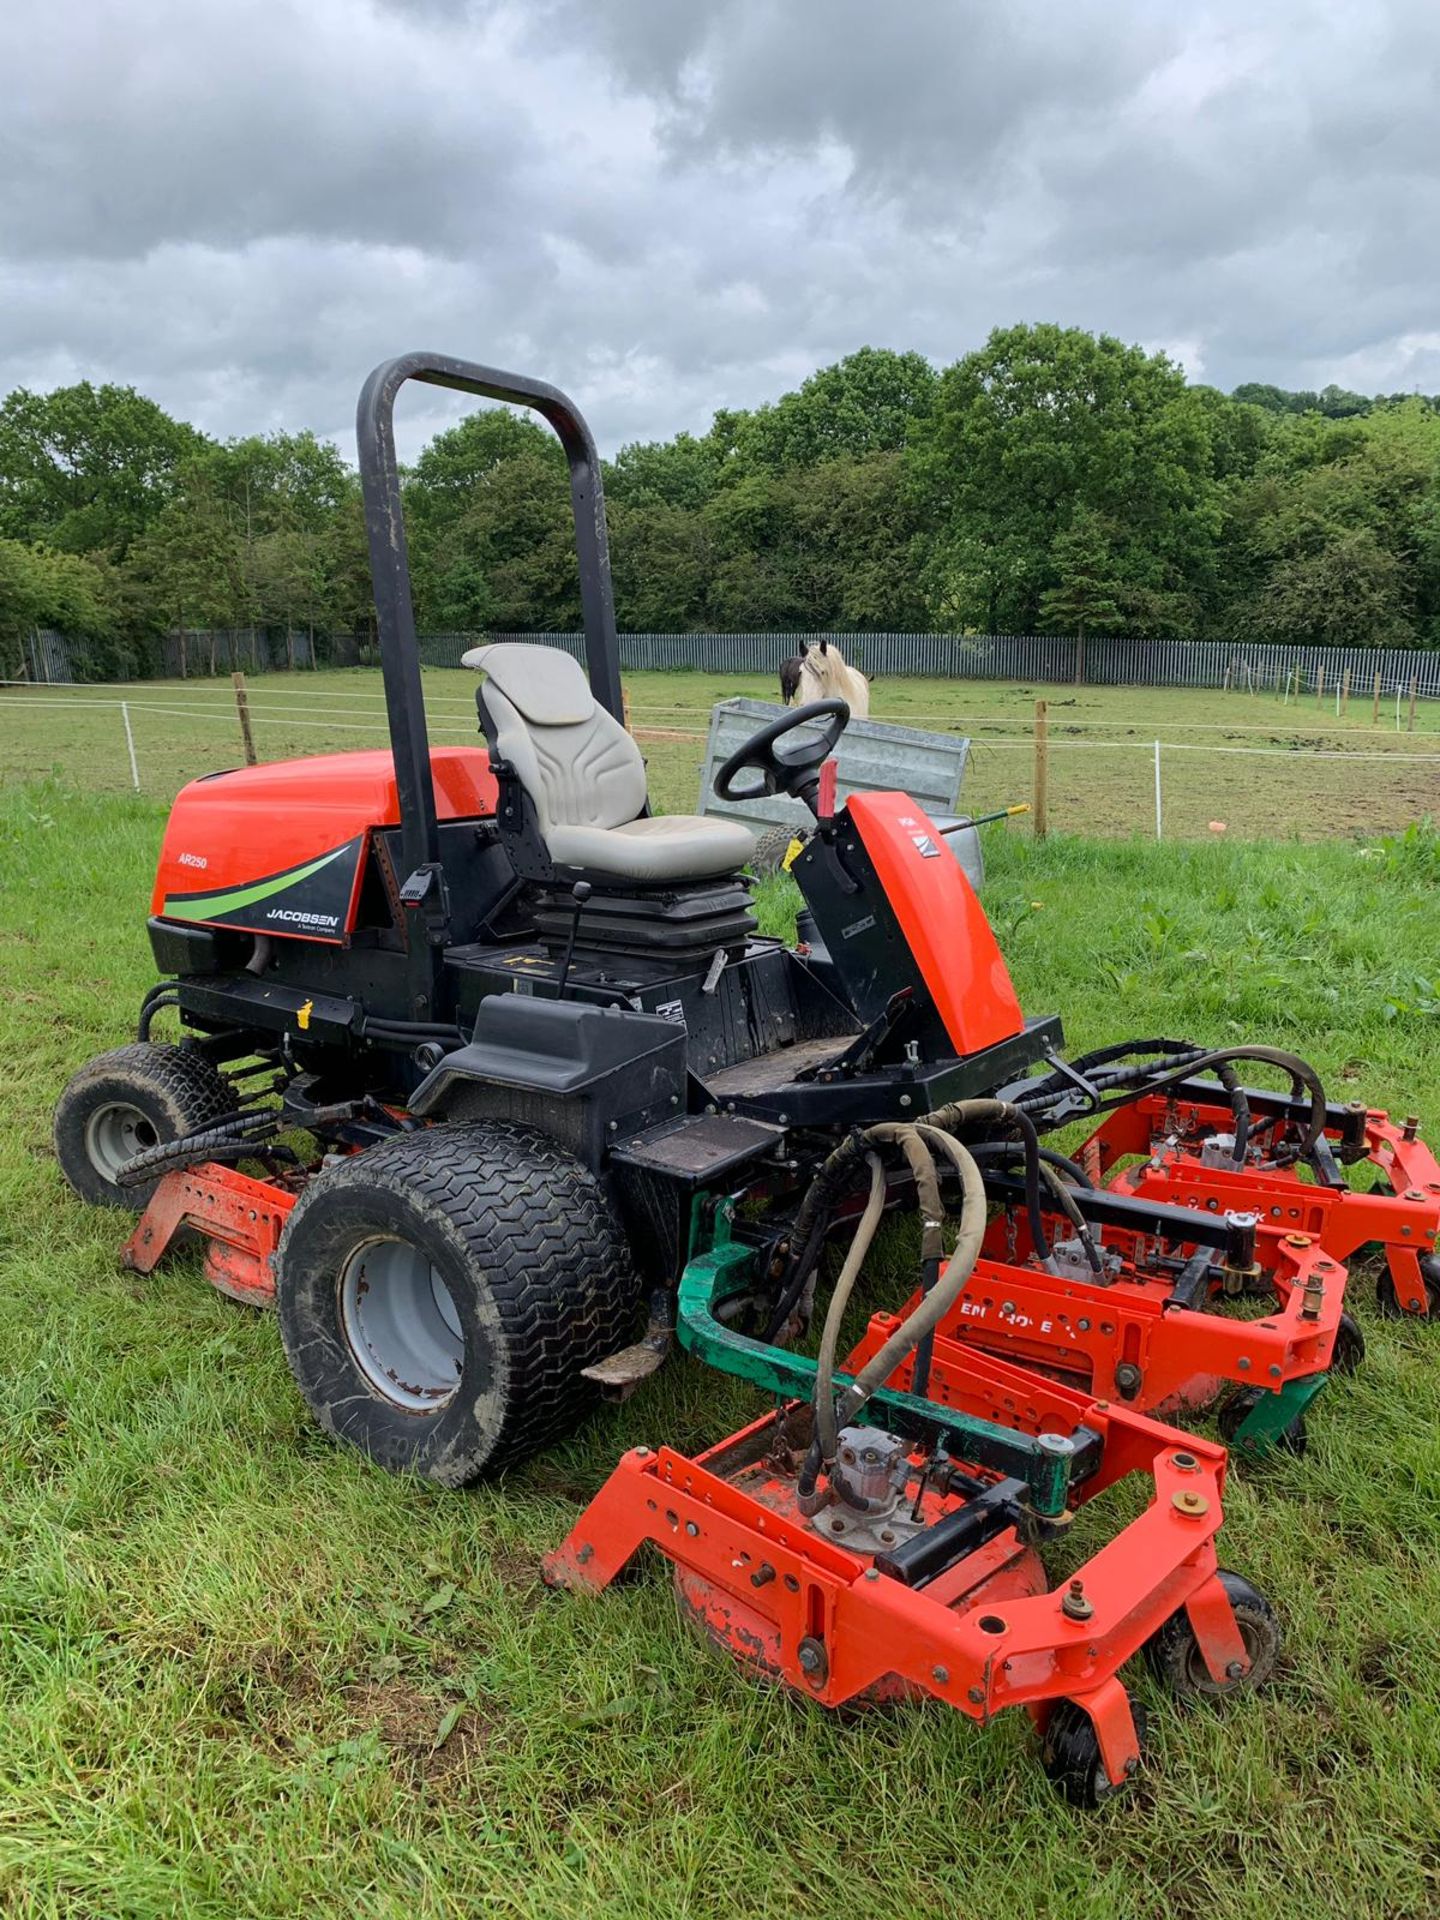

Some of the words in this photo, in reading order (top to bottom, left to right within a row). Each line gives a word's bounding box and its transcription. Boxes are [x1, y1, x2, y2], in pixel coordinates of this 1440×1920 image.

[178, 852, 207, 869] AR250
[266, 909, 339, 927] JACOBSEN
[316, 925, 336, 935] Company
